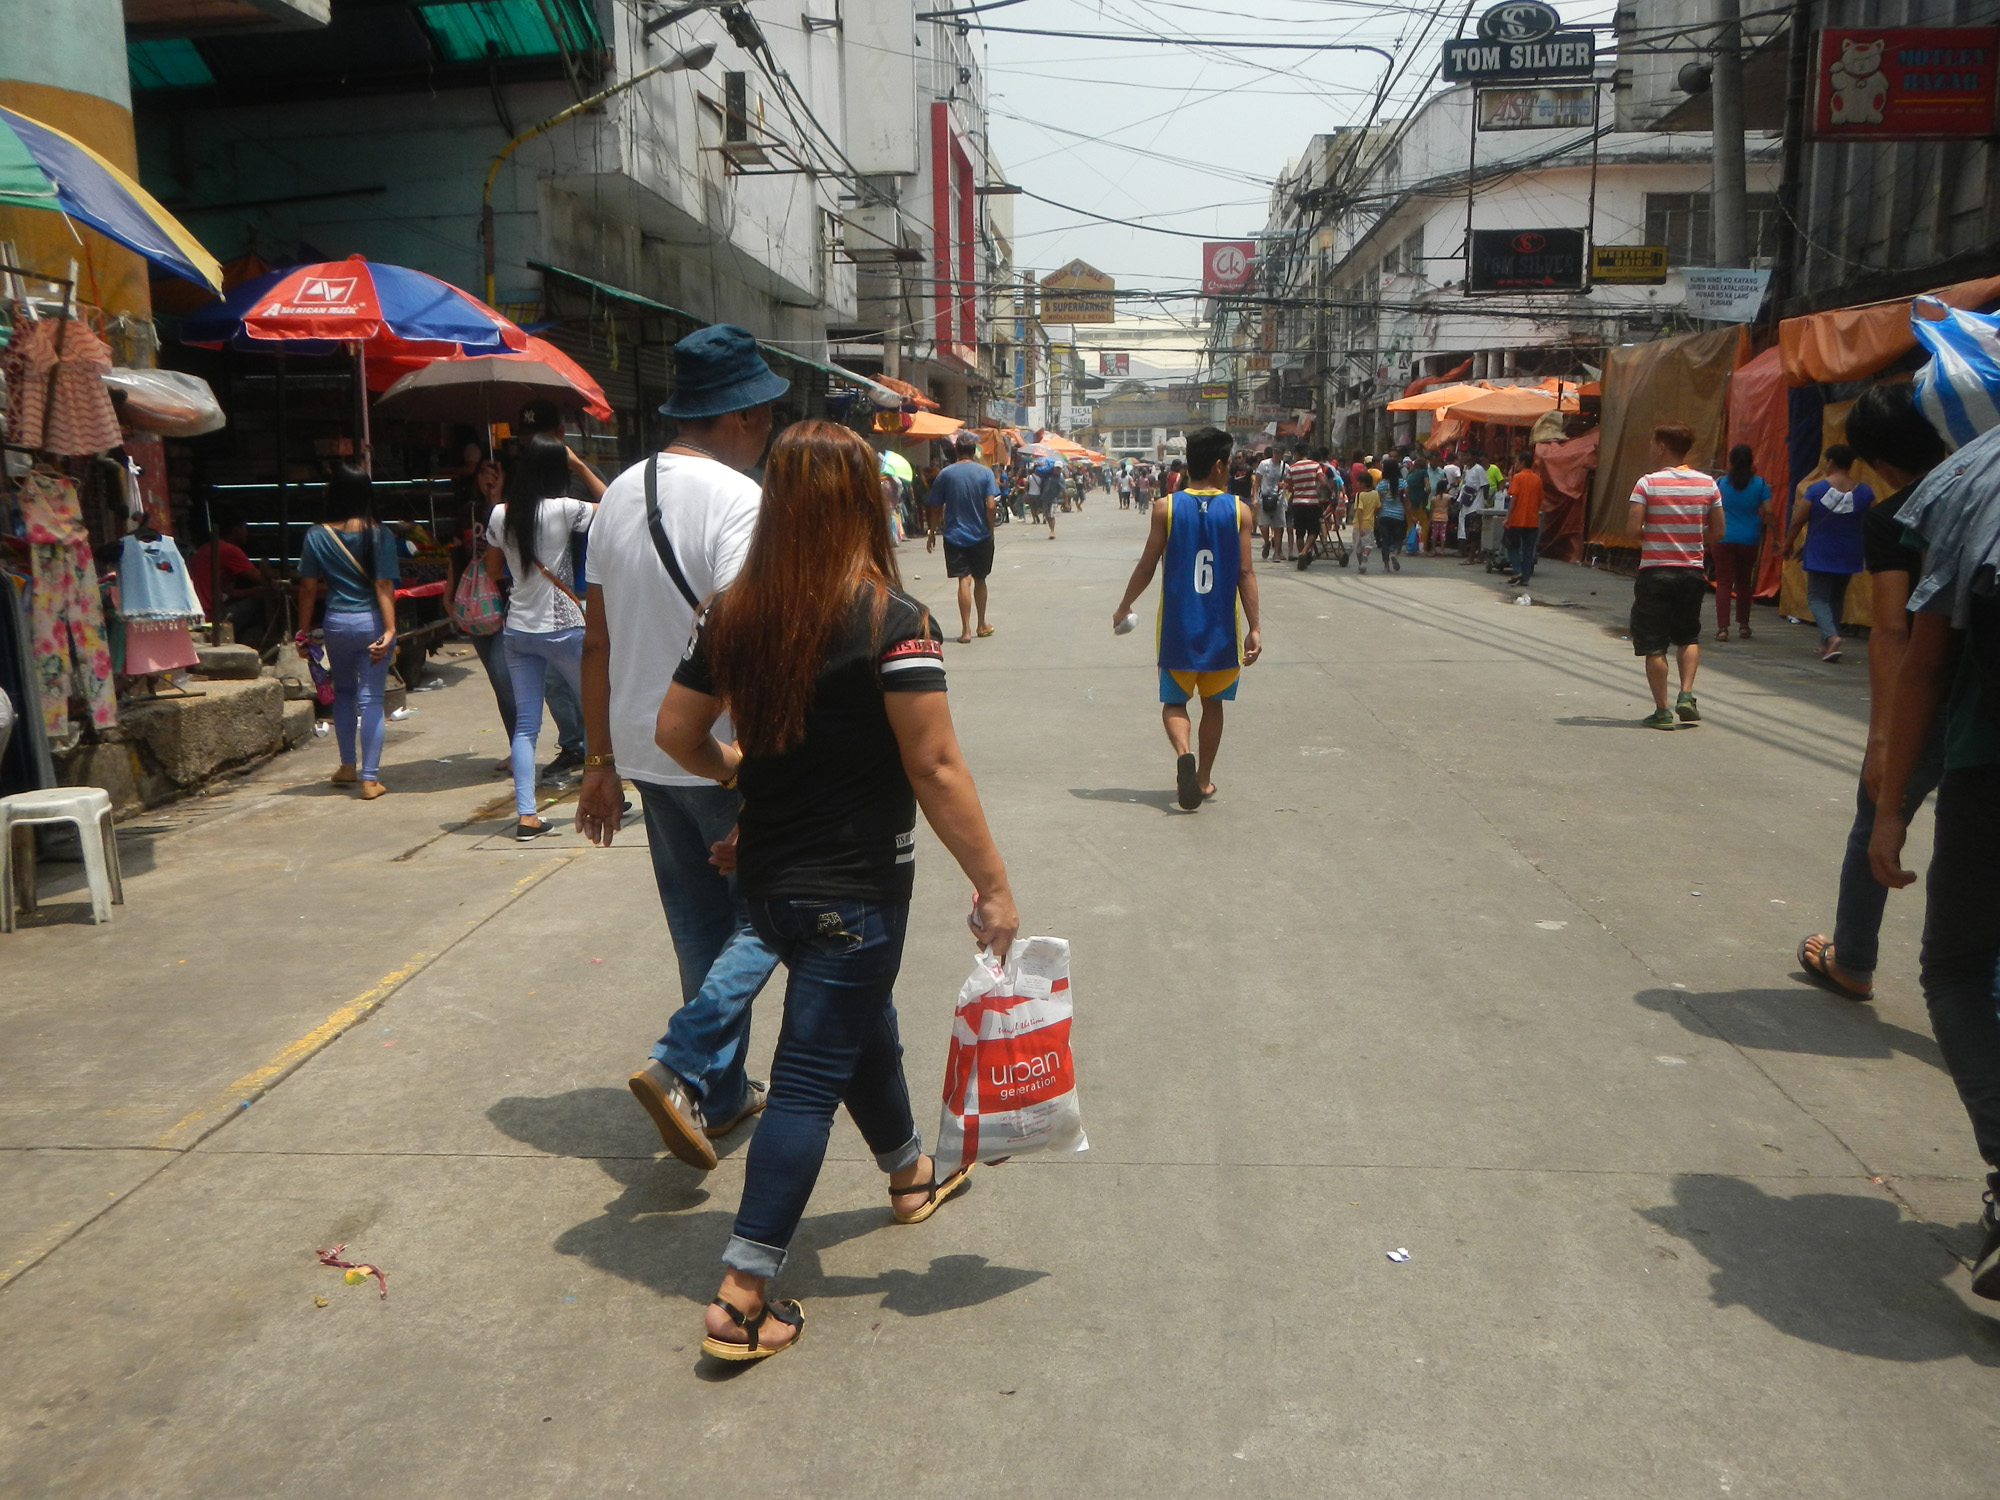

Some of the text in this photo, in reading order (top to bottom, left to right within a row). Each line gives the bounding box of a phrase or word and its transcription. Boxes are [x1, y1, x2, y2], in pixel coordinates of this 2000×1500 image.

[1451, 42, 1590, 72] TOM SILVER
[1897, 49, 1988, 66] MOTLEY
[1903, 73, 1979, 90] BAZAR
[1598, 250, 1652, 258] WESTERN
[1614, 258, 1652, 266] UNION
[1519, 254, 1574, 274] SILVER
[1086, 269, 1104, 283] SALE
[1044, 302, 1111, 313] & SUPERMARKET
[1025, 349, 1034, 404] CENTER
[1194, 549, 1214, 595] 6
[1000, 1075, 1056, 1101] generation
